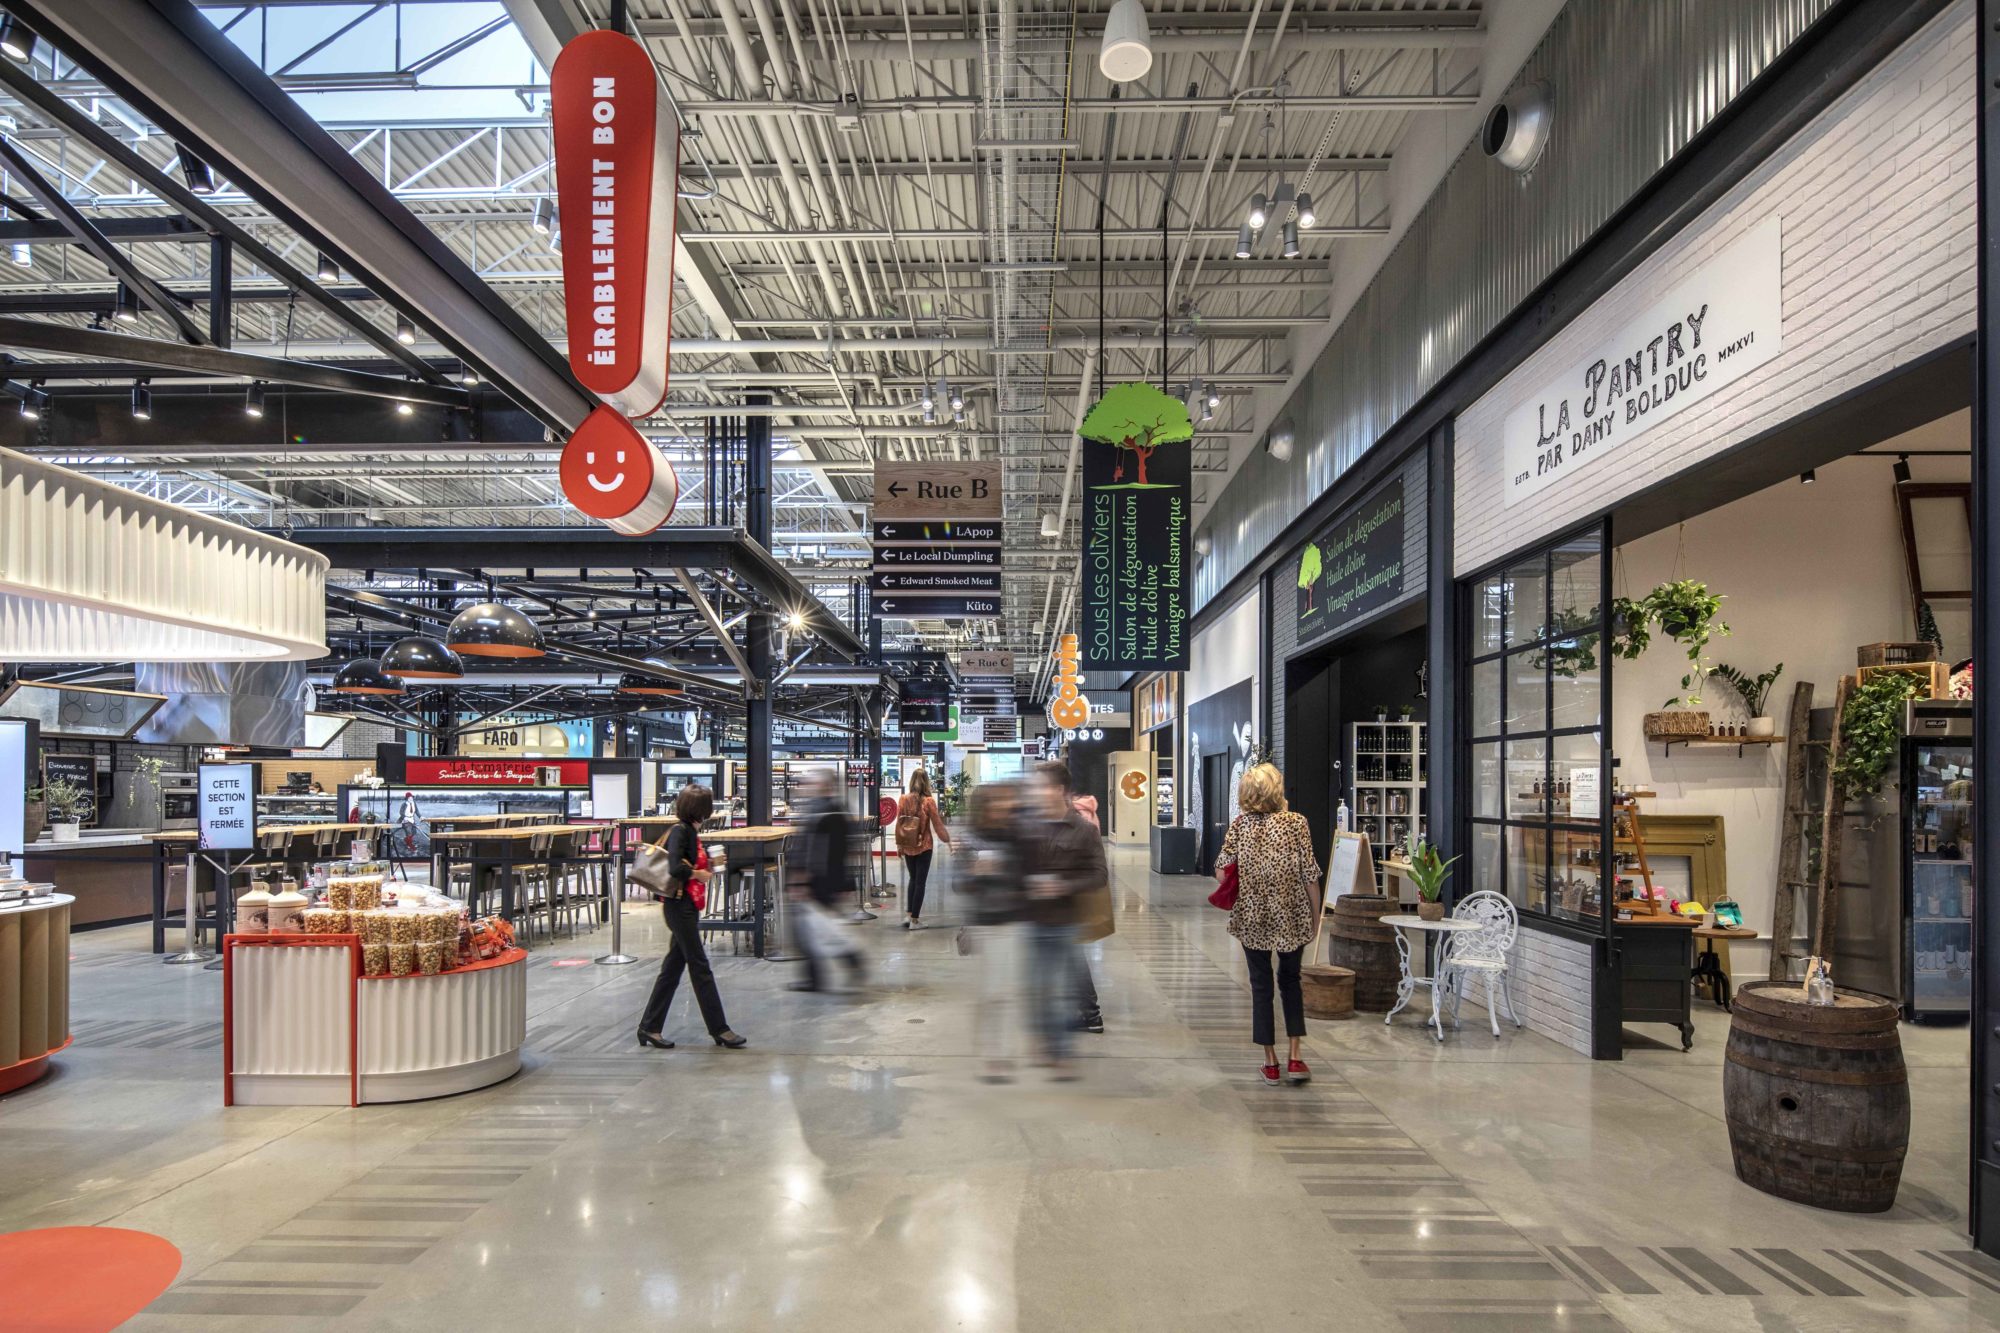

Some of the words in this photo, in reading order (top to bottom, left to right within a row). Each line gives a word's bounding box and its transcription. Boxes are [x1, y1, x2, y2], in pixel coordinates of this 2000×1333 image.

[592, 77, 616, 145] BON
[587, 158, 616, 366] ÉRABLEMENT
[1718, 331, 1755, 363] MMXVI
[1537, 444, 1563, 476] PAR
[1571, 410, 1616, 457] DANY
[1625, 353, 1708, 425] BOLDUC
[917, 480, 963, 499] Rue
[970, 479, 989, 499] B
[956, 526, 994, 539] LApop
[1089, 494, 1110, 570] oliviers
[1119, 494, 1142, 589] dégustation
[1162, 497, 1187, 588] balsamique
[1326, 538, 1344, 562] Salon
[1344, 527, 1354, 547] de
[1354, 499, 1401, 544] dégustation
[899, 551, 913, 561] Le
[914, 551, 941, 561] Local
[943, 551, 994, 563] Dumpling
[1326, 562, 1344, 588] Huile
[1344, 550, 1366, 578] d'olive
[900, 577, 934, 586] Edward
[935, 577, 970, 586] Smoked
[971, 577, 993, 586] Meat
[1089, 573, 1110, 605] les
[1140, 564, 1158, 613] d'olive
[1326, 589, 1355, 614] Vinaigre
[1355, 561, 1401, 598] balsamique
[966, 601, 993, 611] Küto
[1119, 593, 1137, 612] de
[1090, 608, 1110, 661] Sous
[1119, 616, 1137, 661] Salon
[1140, 616, 1158, 660] Huile
[1164, 593, 1186, 662] Vinaigre
[978, 658, 998, 667] Rue
[1000, 657, 1009, 667] C
[208, 793, 245, 802] SECTION
[212, 779, 240, 789] CETTE
[210, 817, 245, 828] FERMÉE
[219, 806, 234, 815] EST
